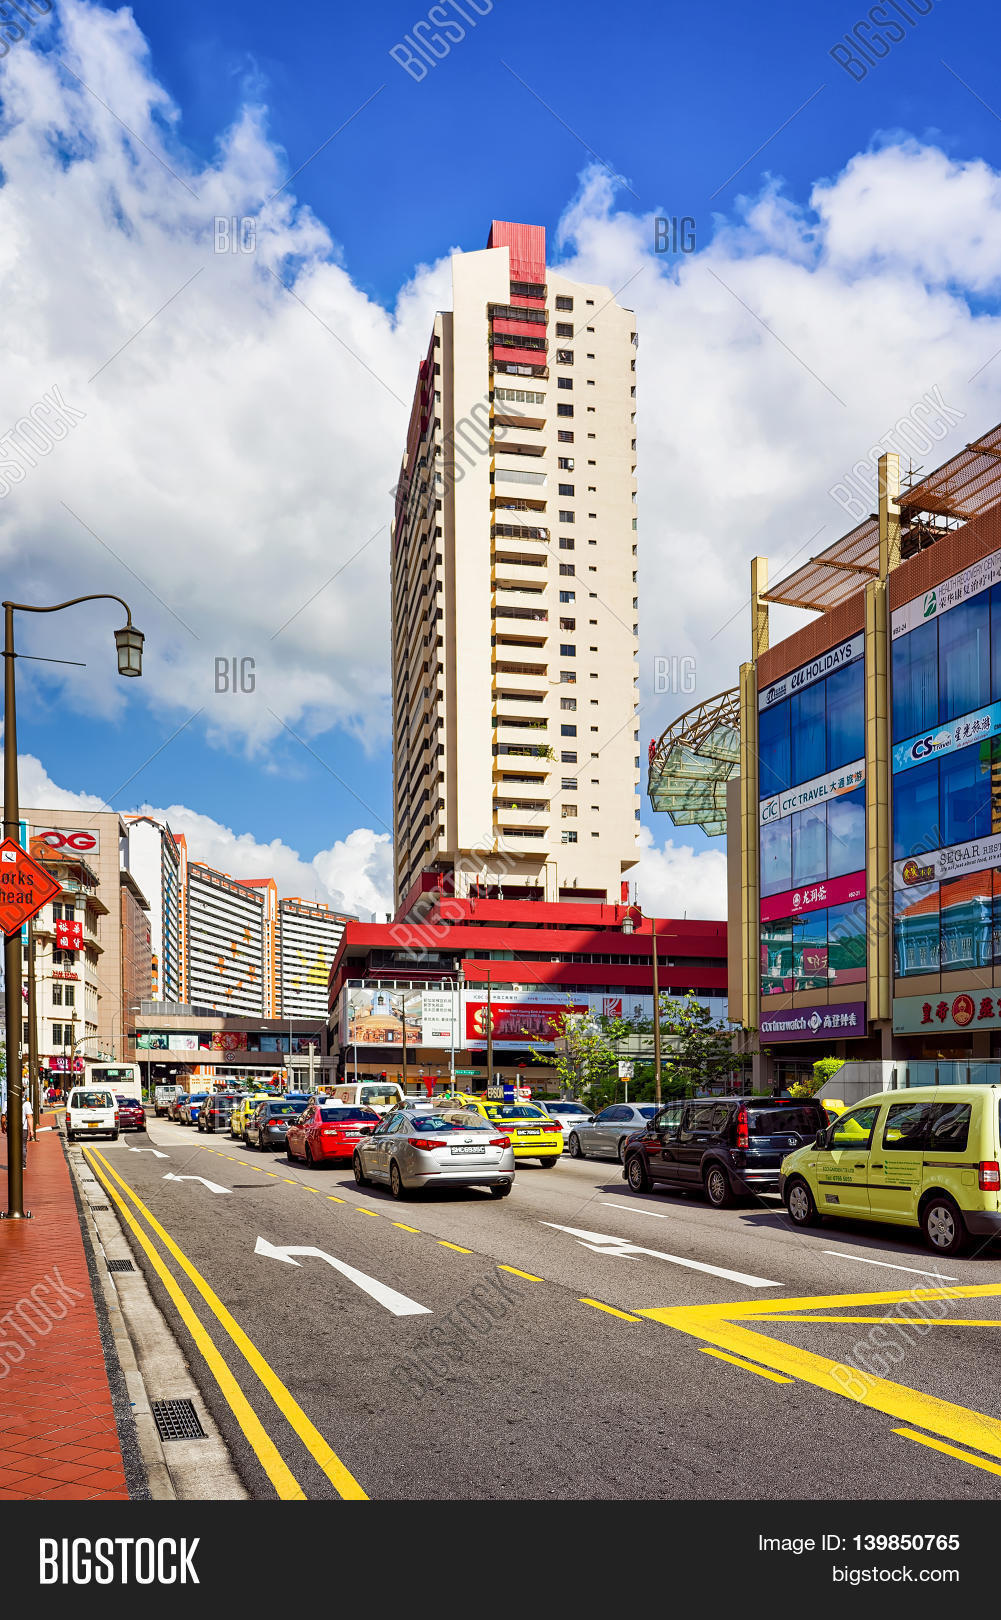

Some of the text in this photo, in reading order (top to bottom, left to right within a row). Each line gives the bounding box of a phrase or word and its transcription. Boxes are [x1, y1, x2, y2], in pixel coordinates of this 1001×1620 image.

[939, 580, 957, 596] HEALTH
[957, 564, 983, 586] RECOVERY
[806, 644, 852, 681] HOLIDAYS
[954, 715, 991, 742] 星光旅游
[911, 735, 933, 759] CS
[932, 739, 952, 752] Travel
[782, 784, 828, 811] CTC TRAVEL
[40, 831, 97, 850] OG
[940, 845, 981, 866] SEGAR
[920, 1001, 950, 1025] 皇帝
[487, 1087, 504, 1099] EPSON
